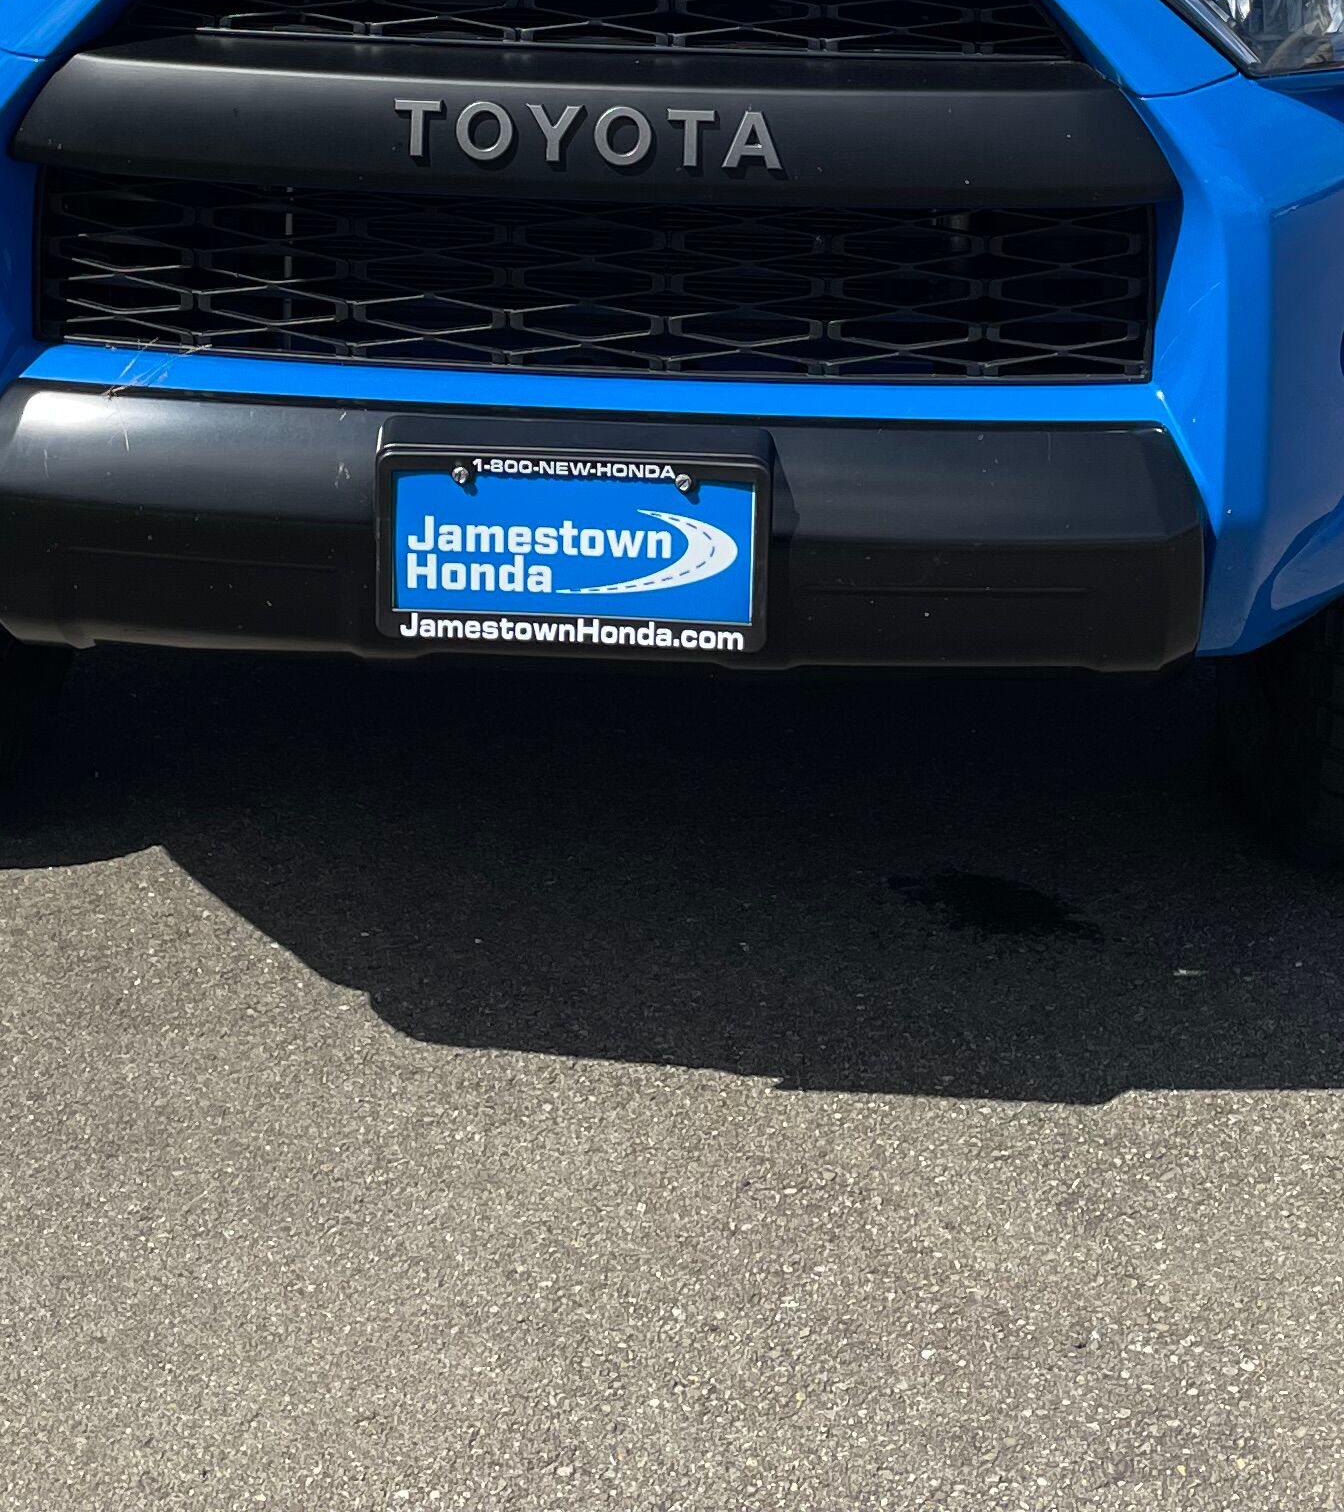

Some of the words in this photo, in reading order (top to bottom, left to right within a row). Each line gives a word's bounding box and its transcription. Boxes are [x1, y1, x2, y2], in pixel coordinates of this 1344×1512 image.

[393, 98, 783, 171] TOYOTA
[471, 458, 677, 479] 1-800-NEW-HONDA
[407, 514, 673, 560] Jamestown
[406, 552, 554, 594] Honda
[399, 612, 745, 652] JamestownHonda.com
